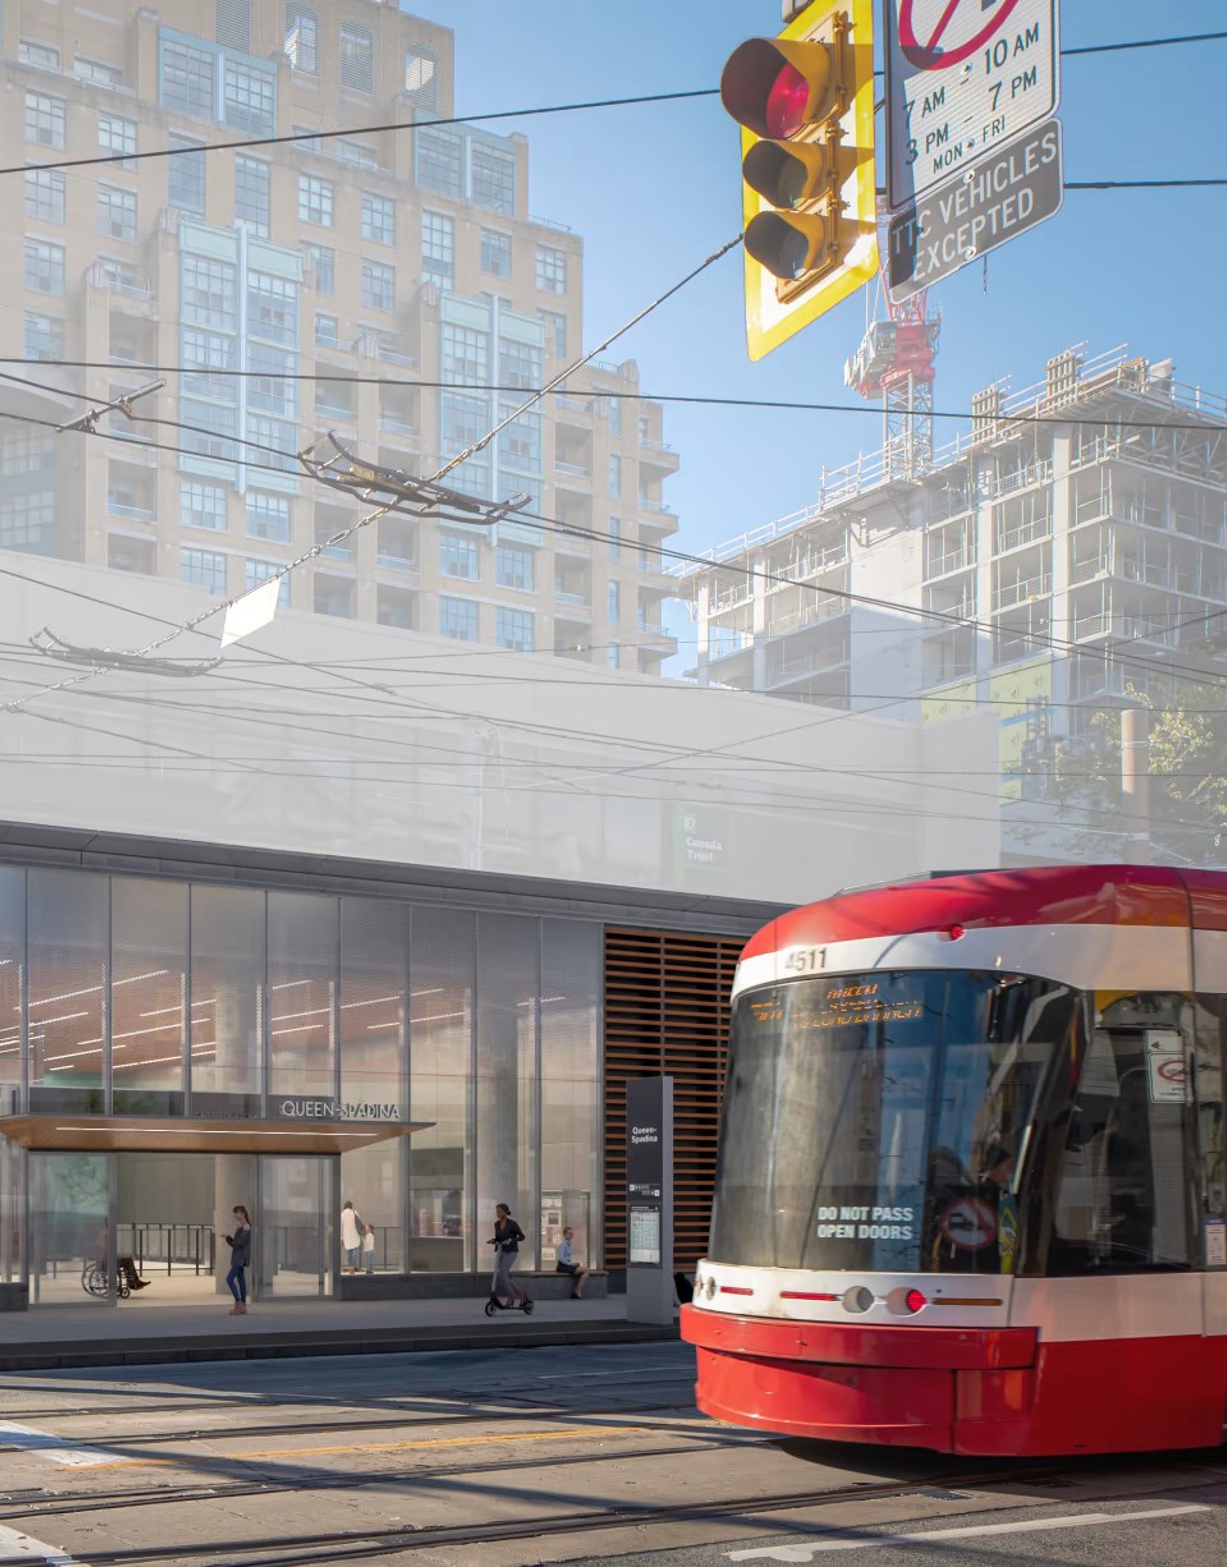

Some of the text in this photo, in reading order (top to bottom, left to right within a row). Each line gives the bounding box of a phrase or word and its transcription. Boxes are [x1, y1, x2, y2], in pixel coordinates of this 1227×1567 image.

[903, 100, 915, 129] 7
[922, 86, 945, 118] AM
[985, 39, 1008, 75] 10
[1013, 22, 1039, 57] AM
[905, 139, 919, 165] 3
[926, 122, 949, 154] PM
[989, 81, 1002, 111] 7
[1011, 65, 1037, 99] PM
[933, 114, 1005, 174] MON FRI
[892, 132, 1057, 254] TTC VEHICLES
[912, 188, 1034, 282] EXCEPTED
[785, 948, 827, 972] 4511
[631, 1135, 658, 1144] Spadina
[632, 1127, 656, 1135] Queen-
[817, 1225, 913, 1240] OPEN DOORS
[818, 1206, 913, 1221] DO NOT PASS
